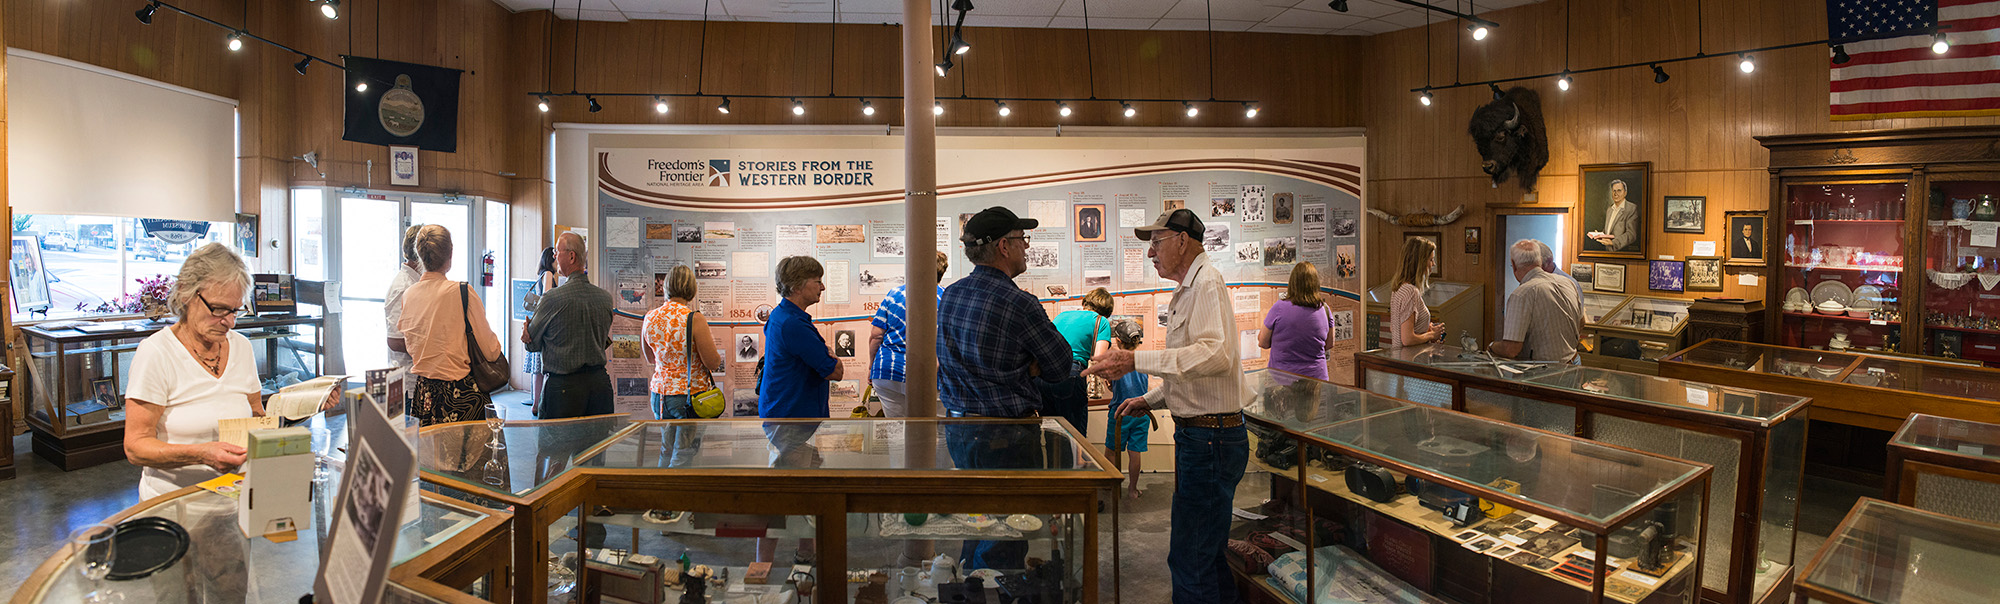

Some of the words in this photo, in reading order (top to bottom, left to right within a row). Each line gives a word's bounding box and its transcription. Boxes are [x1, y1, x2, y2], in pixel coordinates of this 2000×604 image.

[648, 159, 705, 170] Freedom's
[738, 161, 797, 171] STORIES
[802, 161, 841, 171] FROM
[846, 161, 873, 170] THE
[660, 171, 704, 182] Frontier
[738, 173, 806, 186] WESTERN
[813, 172, 874, 186] BORDER
[863, 302, 880, 311] 185
[730, 309, 752, 318] 1854
